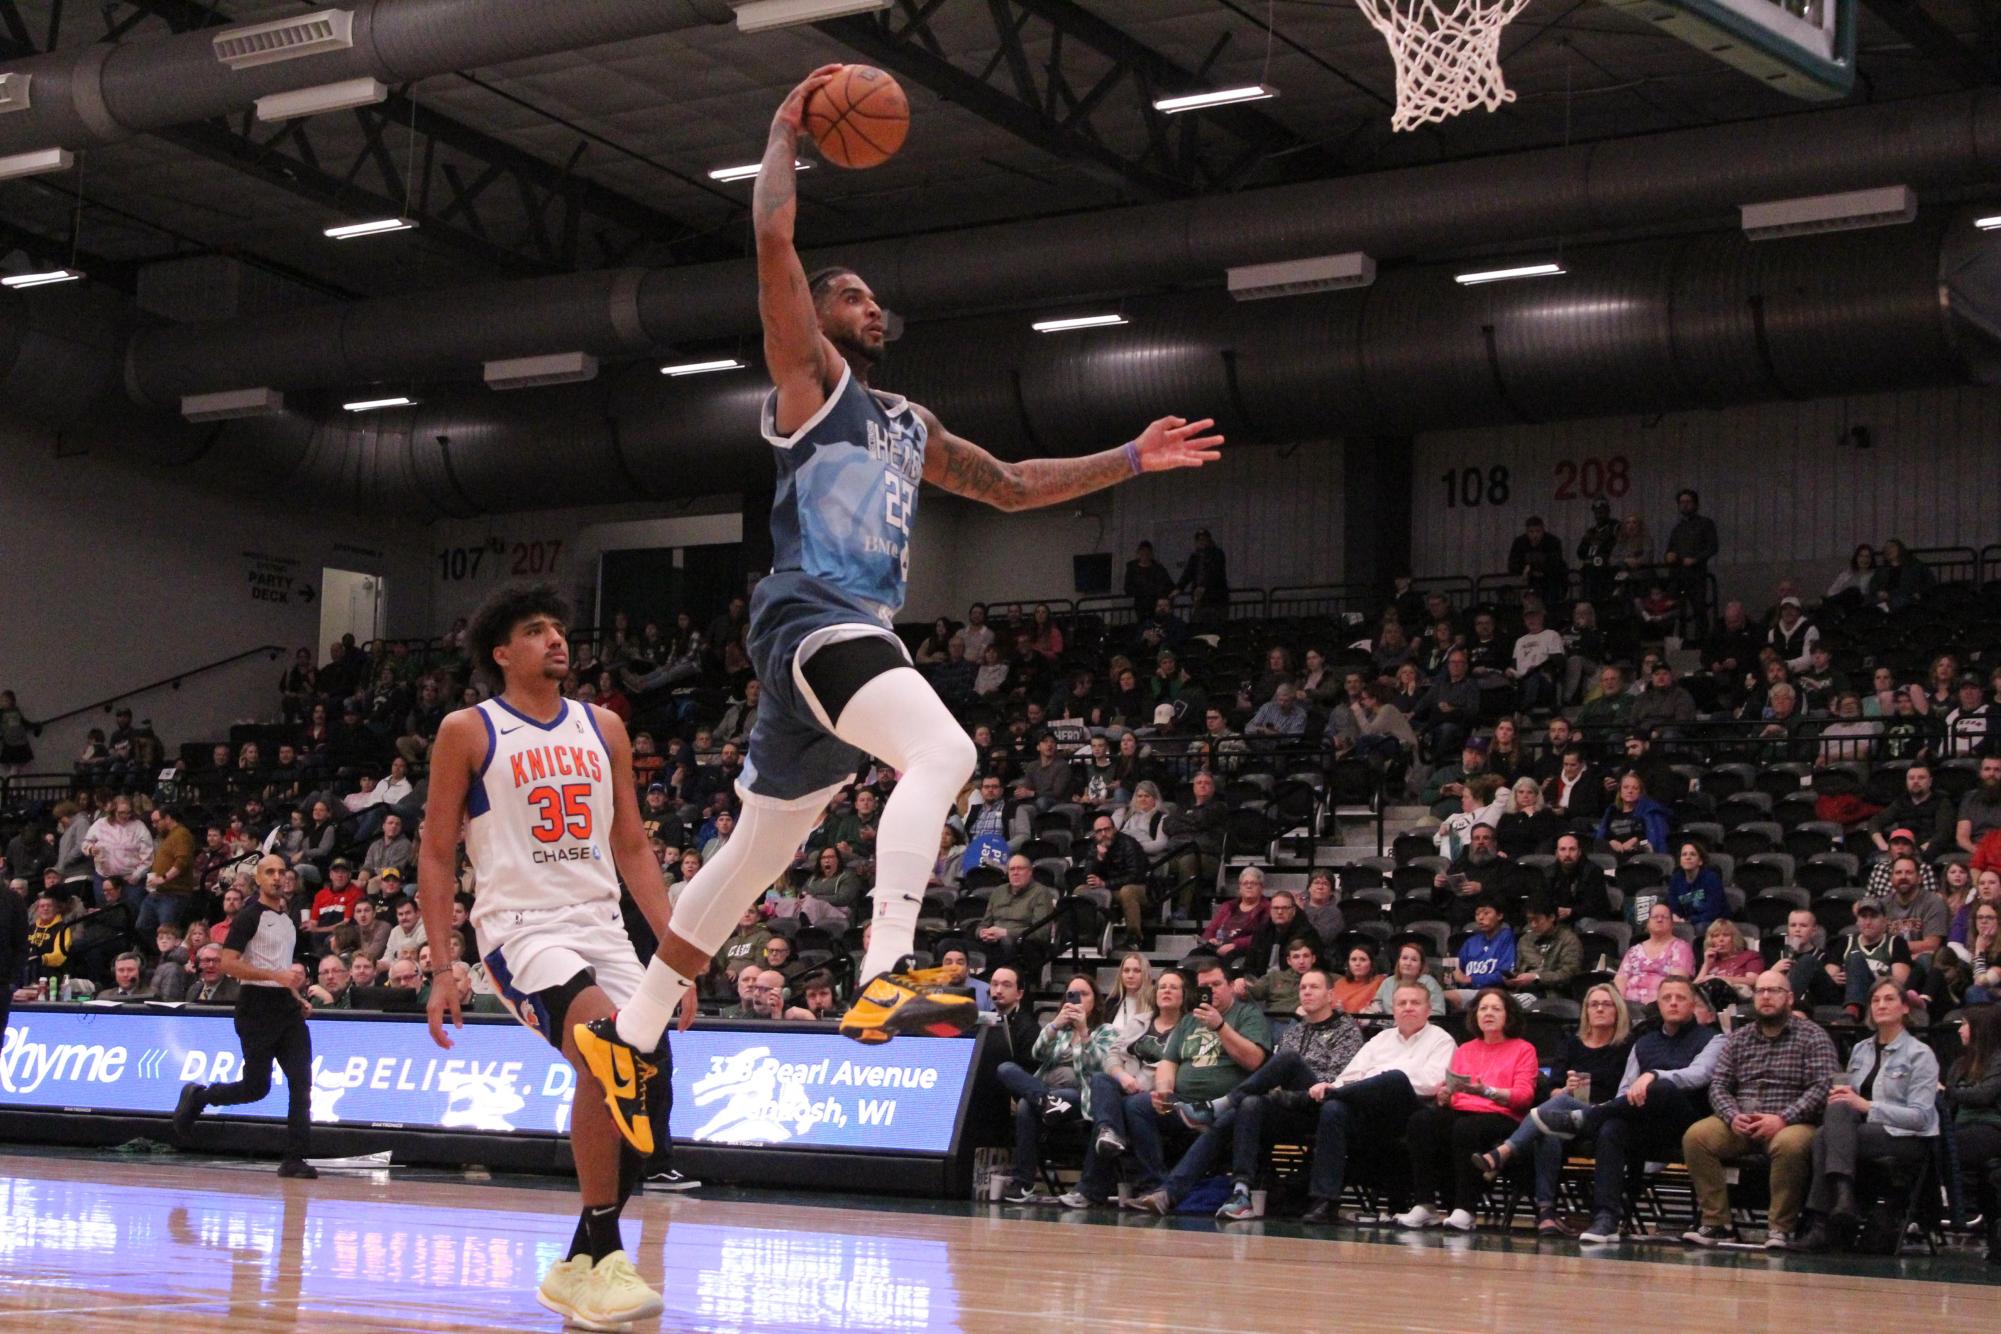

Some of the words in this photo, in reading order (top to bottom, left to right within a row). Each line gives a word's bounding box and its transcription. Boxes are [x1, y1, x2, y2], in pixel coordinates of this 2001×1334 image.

[1441, 464, 1509, 508] 108
[1554, 456, 1630, 500] 208
[884, 470, 917, 538] 22
[249, 571, 294, 589] PARTY
[439, 547, 485, 580] 107
[511, 540, 562, 575] 207
[252, 587, 288, 604] DECK
[510, 745, 602, 788] KNICKS
[528, 783, 592, 843] 35
[532, 847, 590, 864] CHASE
[0, 1027, 127, 1093] Rhyme
[759, 1057, 829, 1085] Pearl
[831, 1061, 937, 1089] Avenue
[858, 1099, 897, 1126] WI
